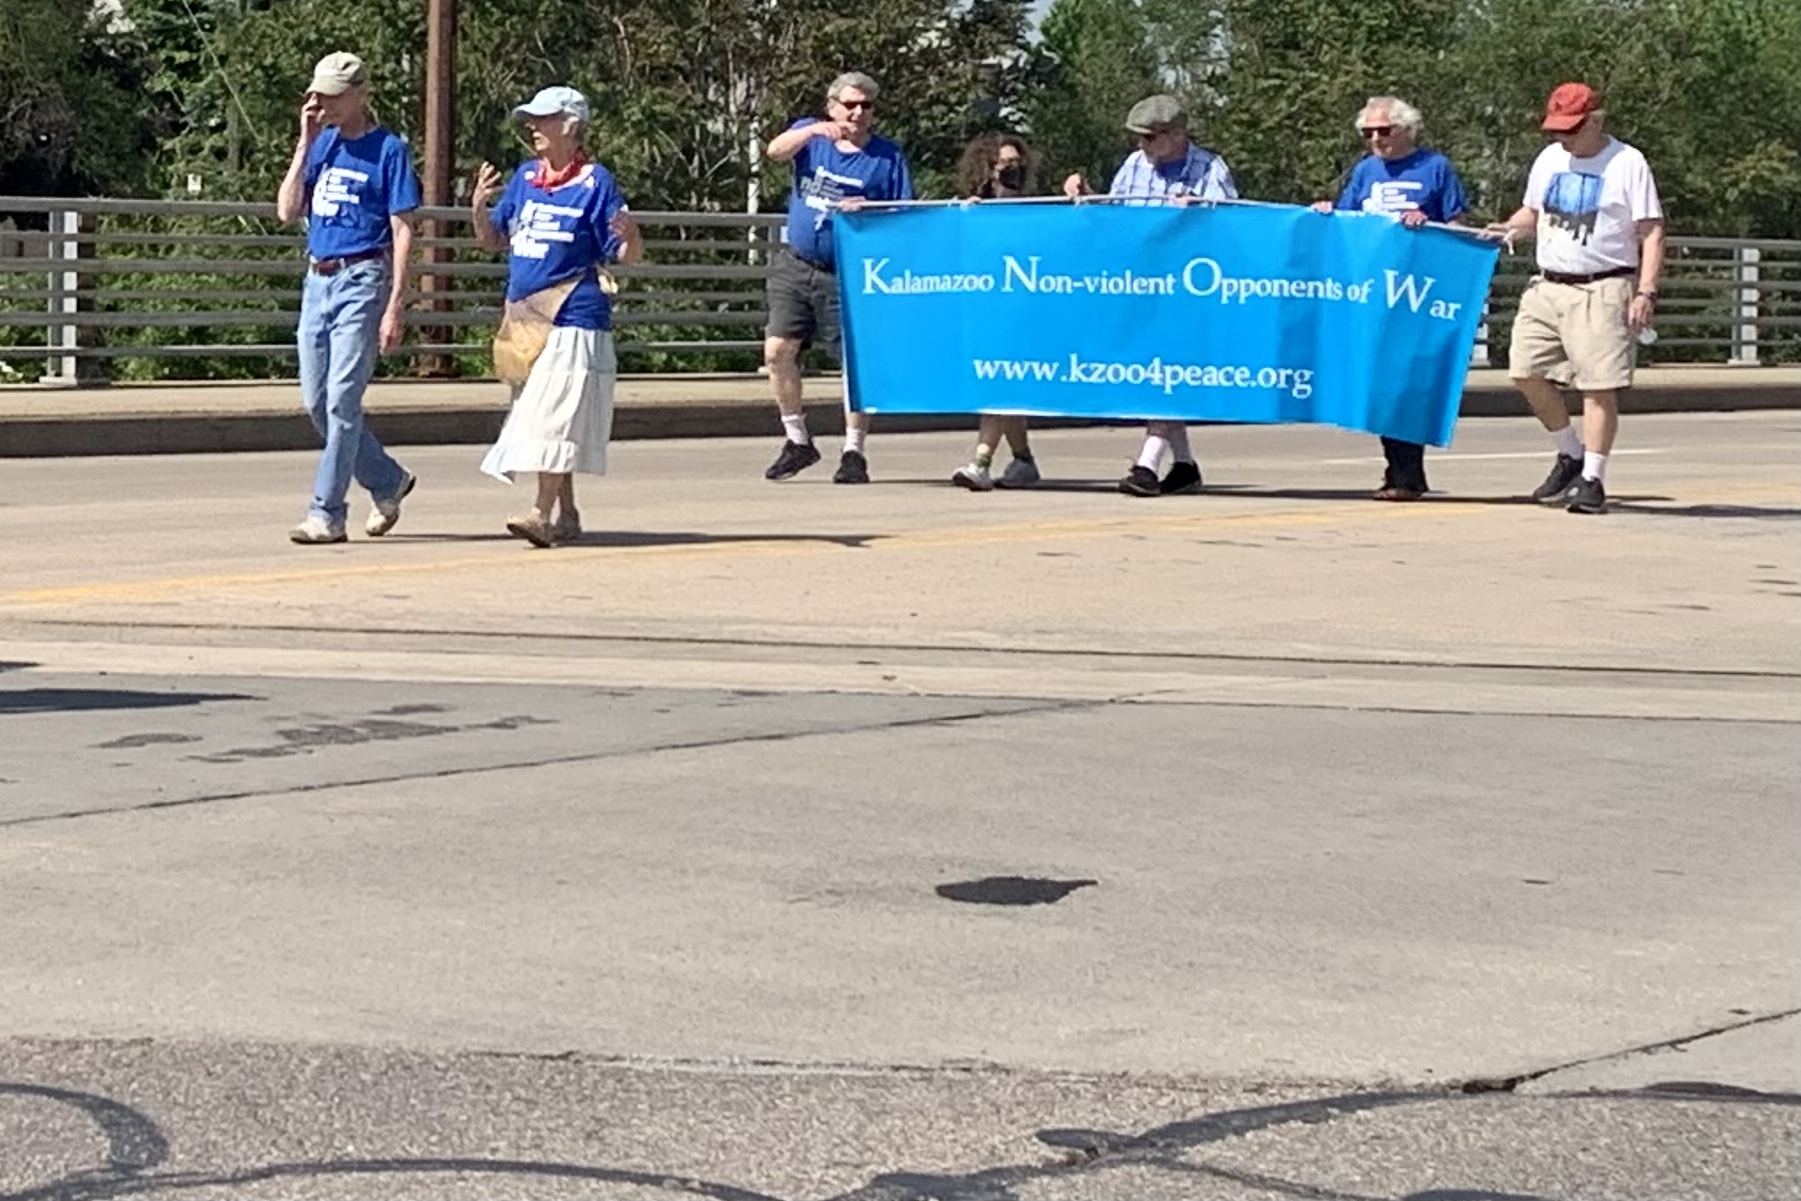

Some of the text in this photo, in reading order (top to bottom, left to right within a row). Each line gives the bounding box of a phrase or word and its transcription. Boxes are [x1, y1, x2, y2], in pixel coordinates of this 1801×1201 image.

[863, 256, 1462, 320] Kalamazoo Non-violent Opponents of War
[973, 354, 1314, 399] www.kzoo4peace.org
